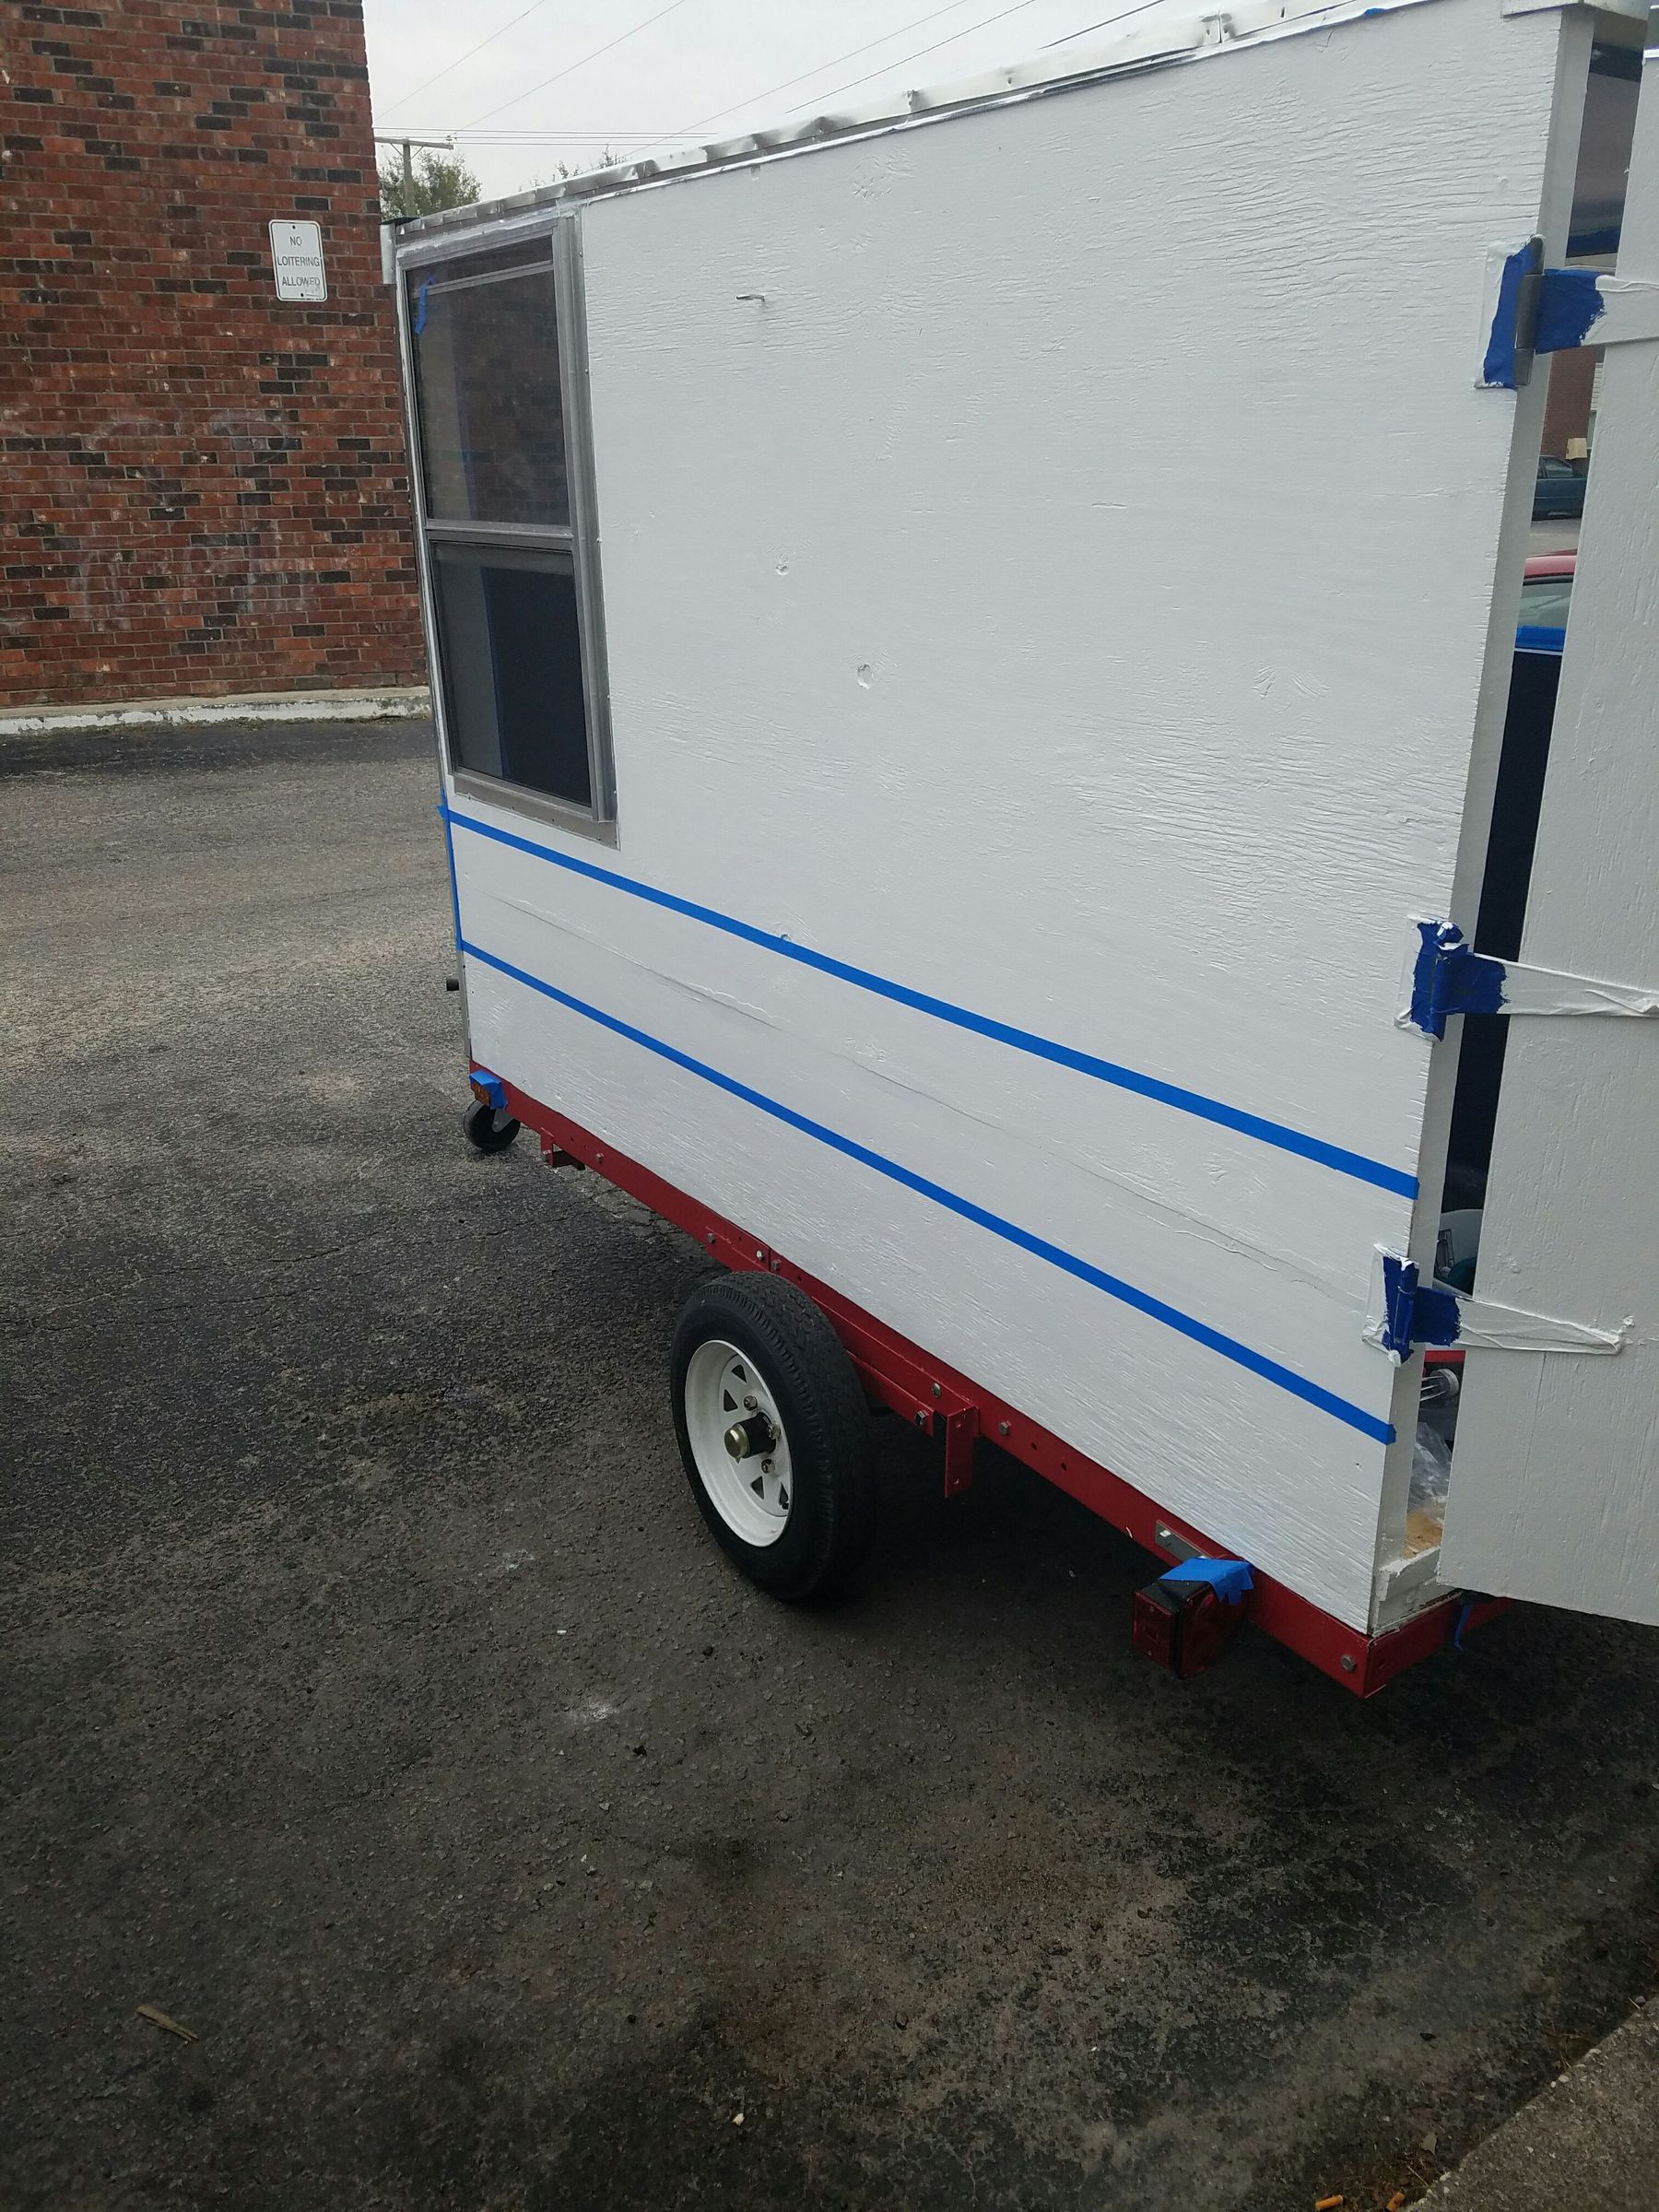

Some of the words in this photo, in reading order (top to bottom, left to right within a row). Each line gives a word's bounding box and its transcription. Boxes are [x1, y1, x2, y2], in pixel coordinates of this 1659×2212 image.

[289, 236, 302, 246] NO
[276, 256, 320, 266] LOITERING
[281, 276, 320, 287] ALLOWED
